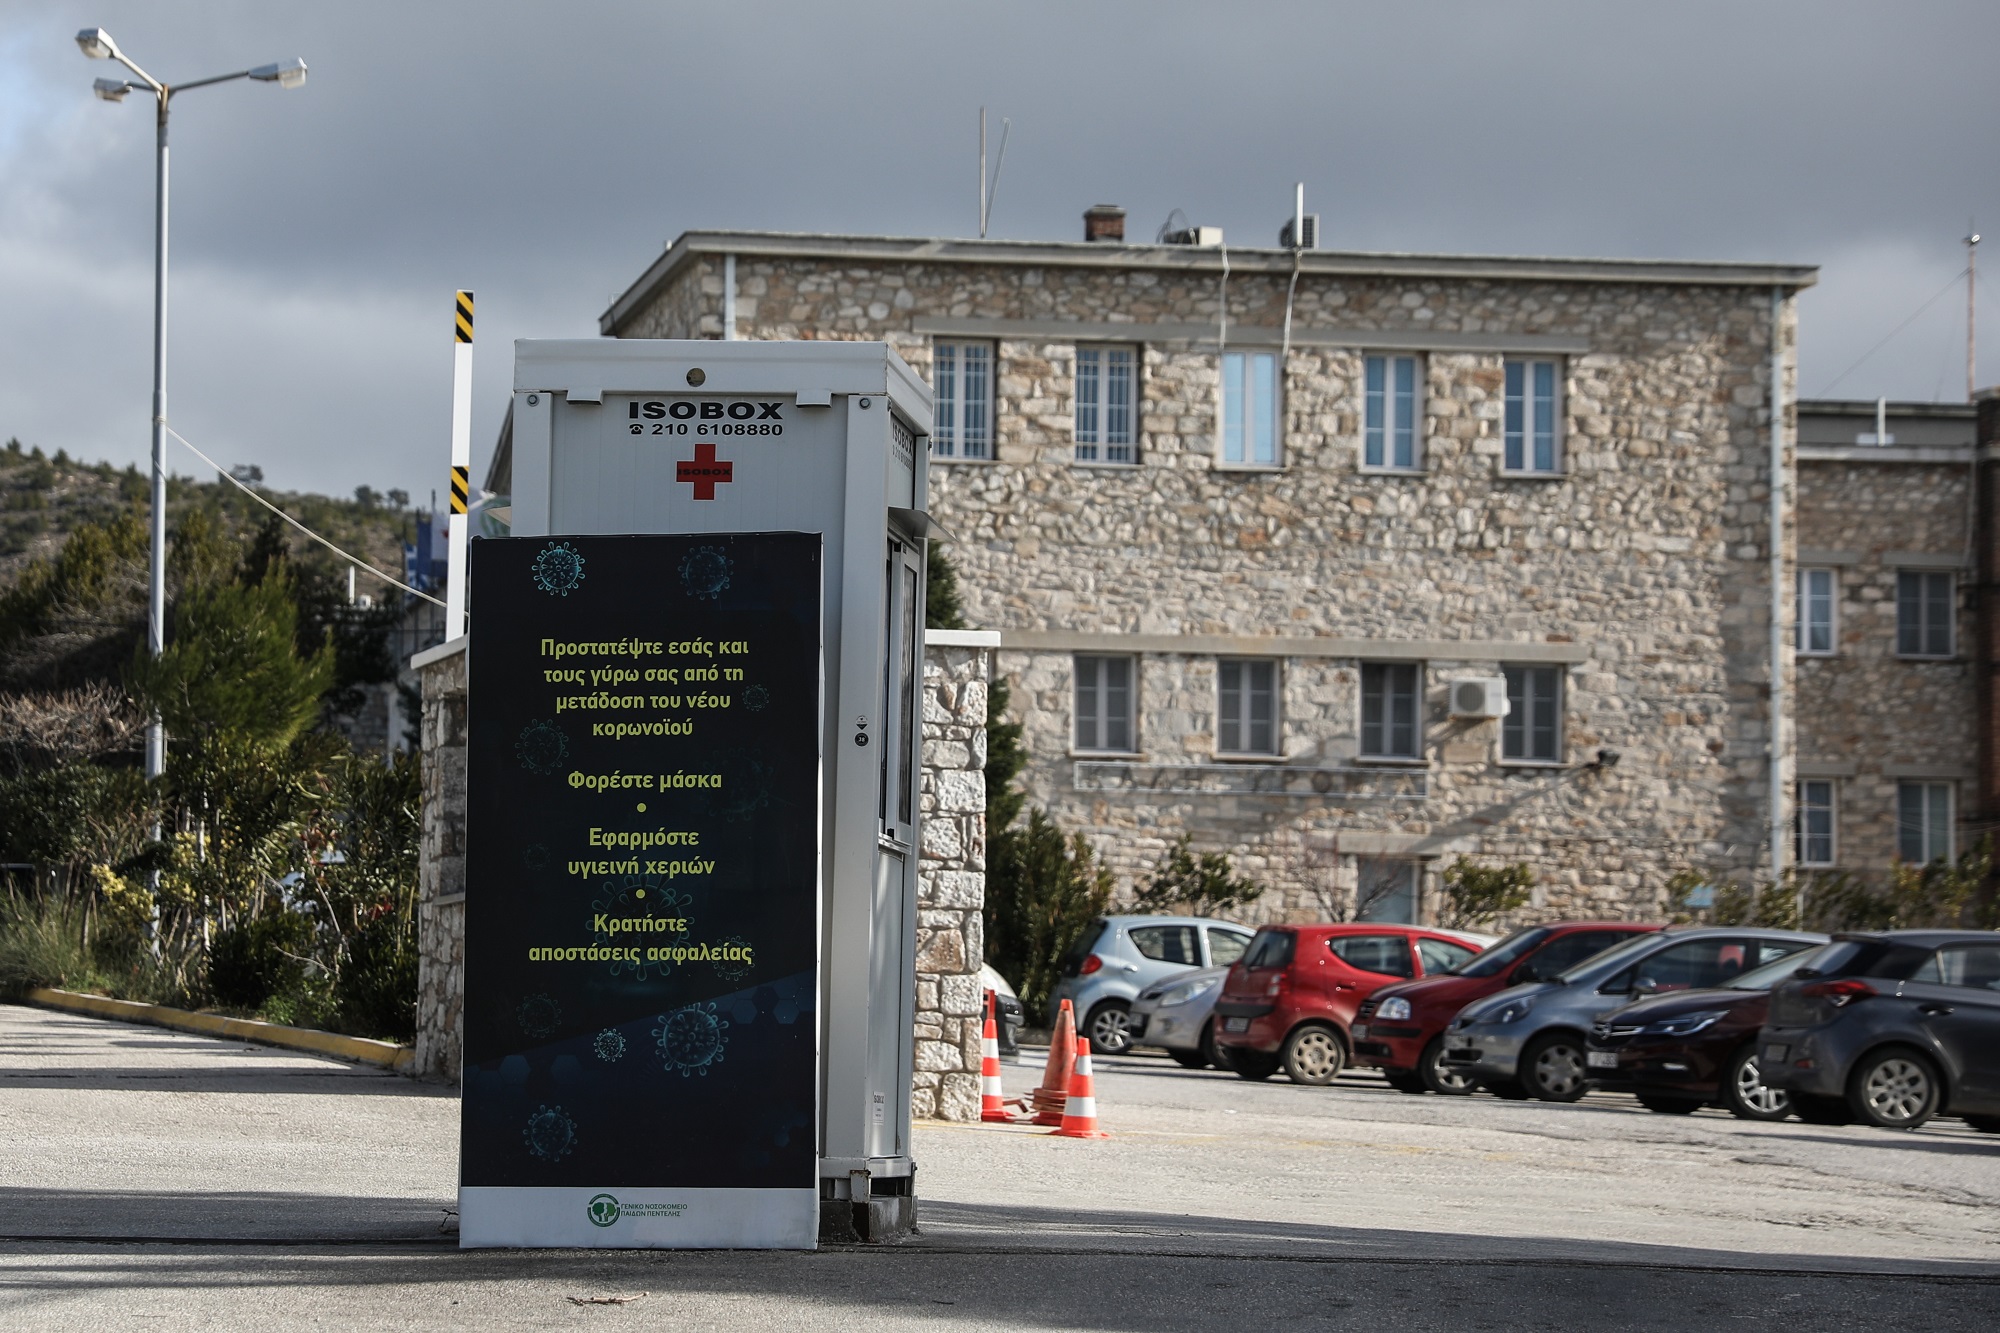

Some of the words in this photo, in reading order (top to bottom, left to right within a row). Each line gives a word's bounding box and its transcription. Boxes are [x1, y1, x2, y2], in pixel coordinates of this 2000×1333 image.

[629, 401, 784, 420] ISOBOX
[651, 423, 688, 436] 210
[696, 423, 784, 436] 6108880
[678, 468, 732, 477] ISOBOX
[541, 637, 663, 660] Προστατέψτε
[668, 637, 714, 658] εσάς
[719, 641, 749, 655] και
[544, 669, 585, 687] τους
[590, 665, 640, 686] γύρω
[644, 668, 679, 685] σας
[684, 664, 719, 682] από
[724, 668, 744, 681] τη
[556, 691, 645, 714] μετάδοση
[649, 695, 681, 709] του
[686, 691, 731, 709] νέου
[592, 717, 693, 740] κορωνοϊού
[567, 770, 654, 793] Φορέστε
[659, 769, 722, 793] μάσκα
[589, 827, 699, 851] Εφαρμόστε
[568, 856, 639, 880] υγιεινή
[645, 856, 716, 879] χεριών
[593, 913, 687, 937] Κρατήστε
[528, 942, 641, 965] αποστάσεις
[646, 942, 753, 965] ασφαλείας
